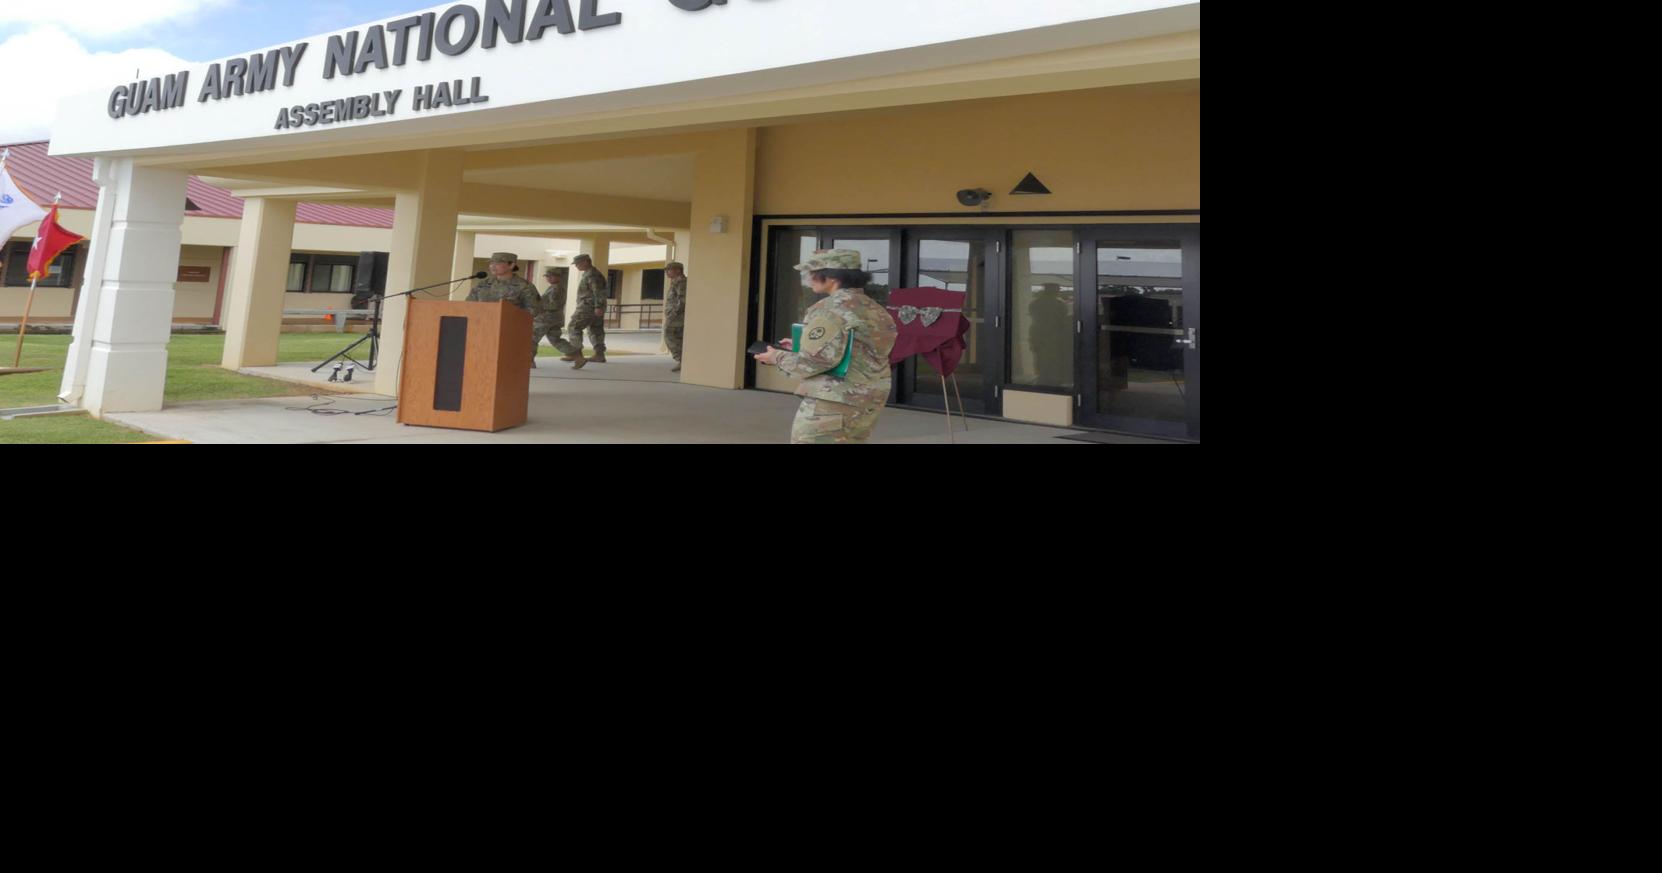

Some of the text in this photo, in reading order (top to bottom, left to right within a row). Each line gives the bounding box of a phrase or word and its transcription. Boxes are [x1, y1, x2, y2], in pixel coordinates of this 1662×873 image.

[107, 0, 622, 119] GUAM ARMY NATIONAL
[274, 77, 489, 130] ASSEMBLY HALL
